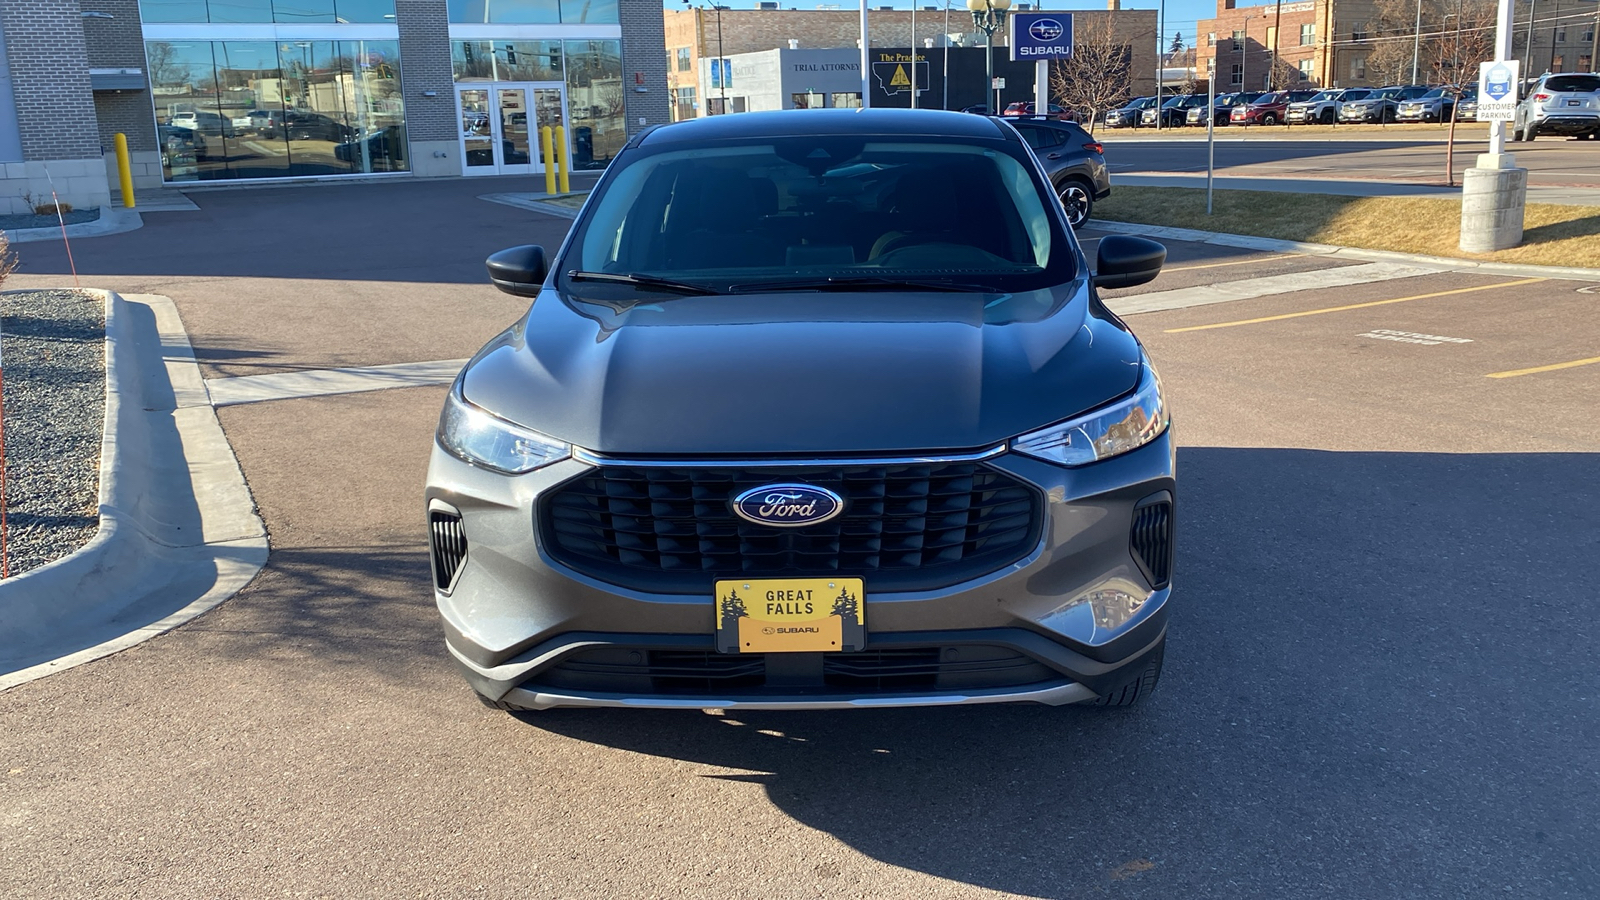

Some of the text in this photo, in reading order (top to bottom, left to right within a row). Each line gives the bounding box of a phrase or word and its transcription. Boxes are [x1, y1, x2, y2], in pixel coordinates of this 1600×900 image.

[1020, 46, 1069, 55] SUBARU
[879, 53, 926, 61] The Pracice
[758, 493, 816, 517] Ford
[766, 590, 813, 601] GREAT
[766, 602, 813, 615] FALLS
[777, 626, 819, 634] SUBARU
